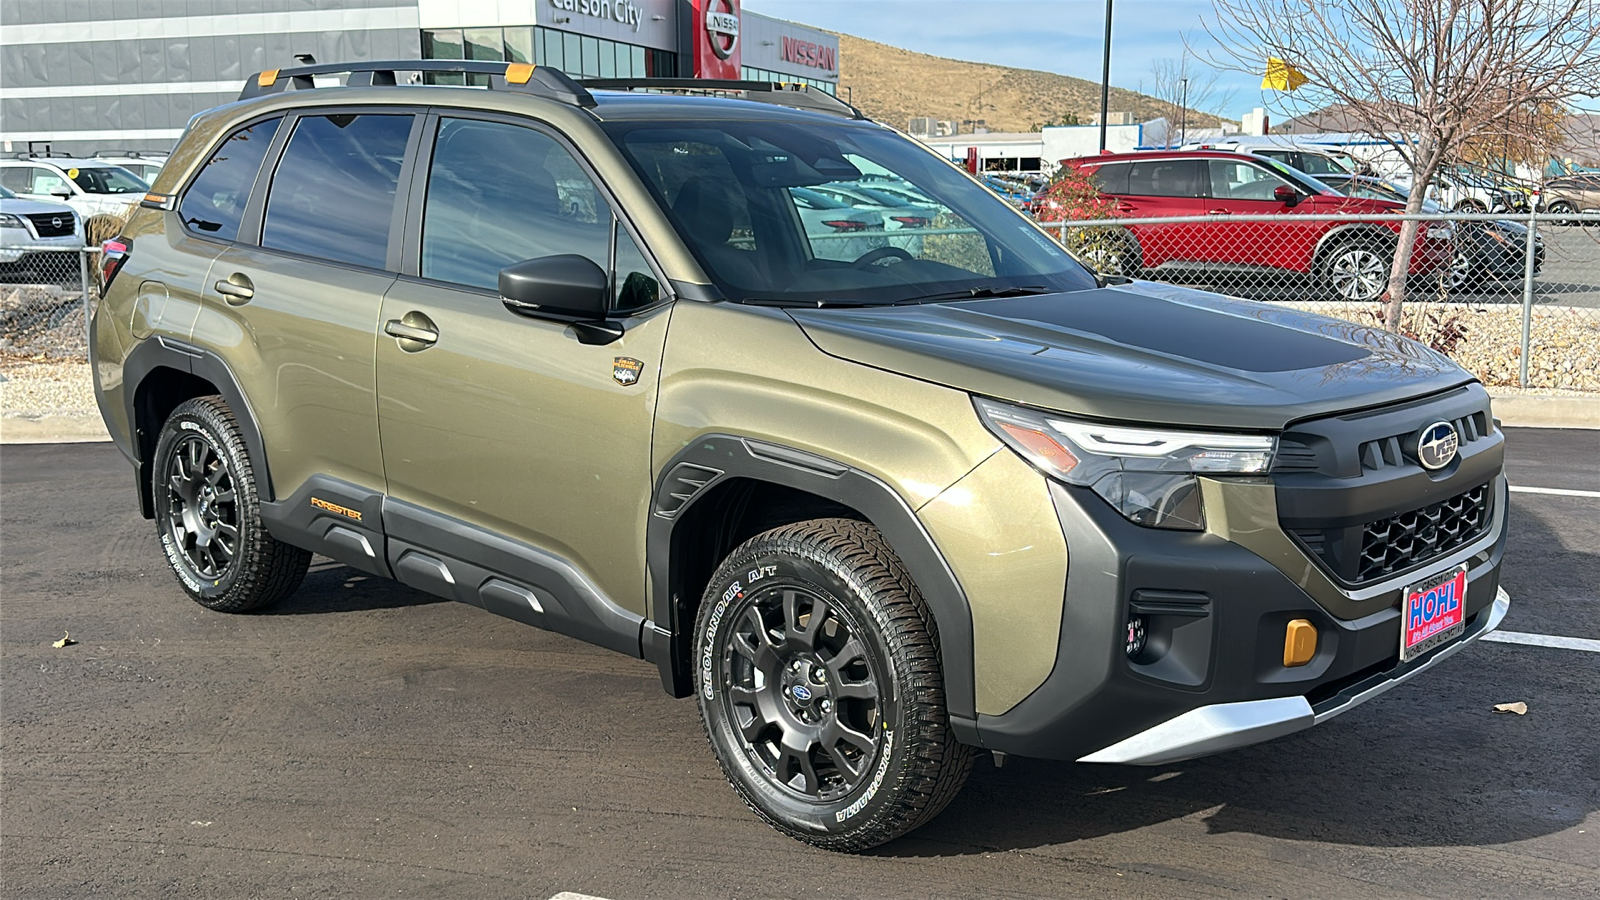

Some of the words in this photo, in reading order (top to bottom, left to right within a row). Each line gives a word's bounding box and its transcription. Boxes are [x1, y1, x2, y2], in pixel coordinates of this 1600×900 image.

[614, 0, 643, 32] City
[782, 35, 835, 71] NISSAN
[311, 496, 362, 521] FORESTER
[1409, 580, 1458, 630] HOHL
[702, 580, 743, 700] GEOLANDAR
[748, 565, 778, 584] A/T
[836, 730, 894, 823] YOKOHAMA
